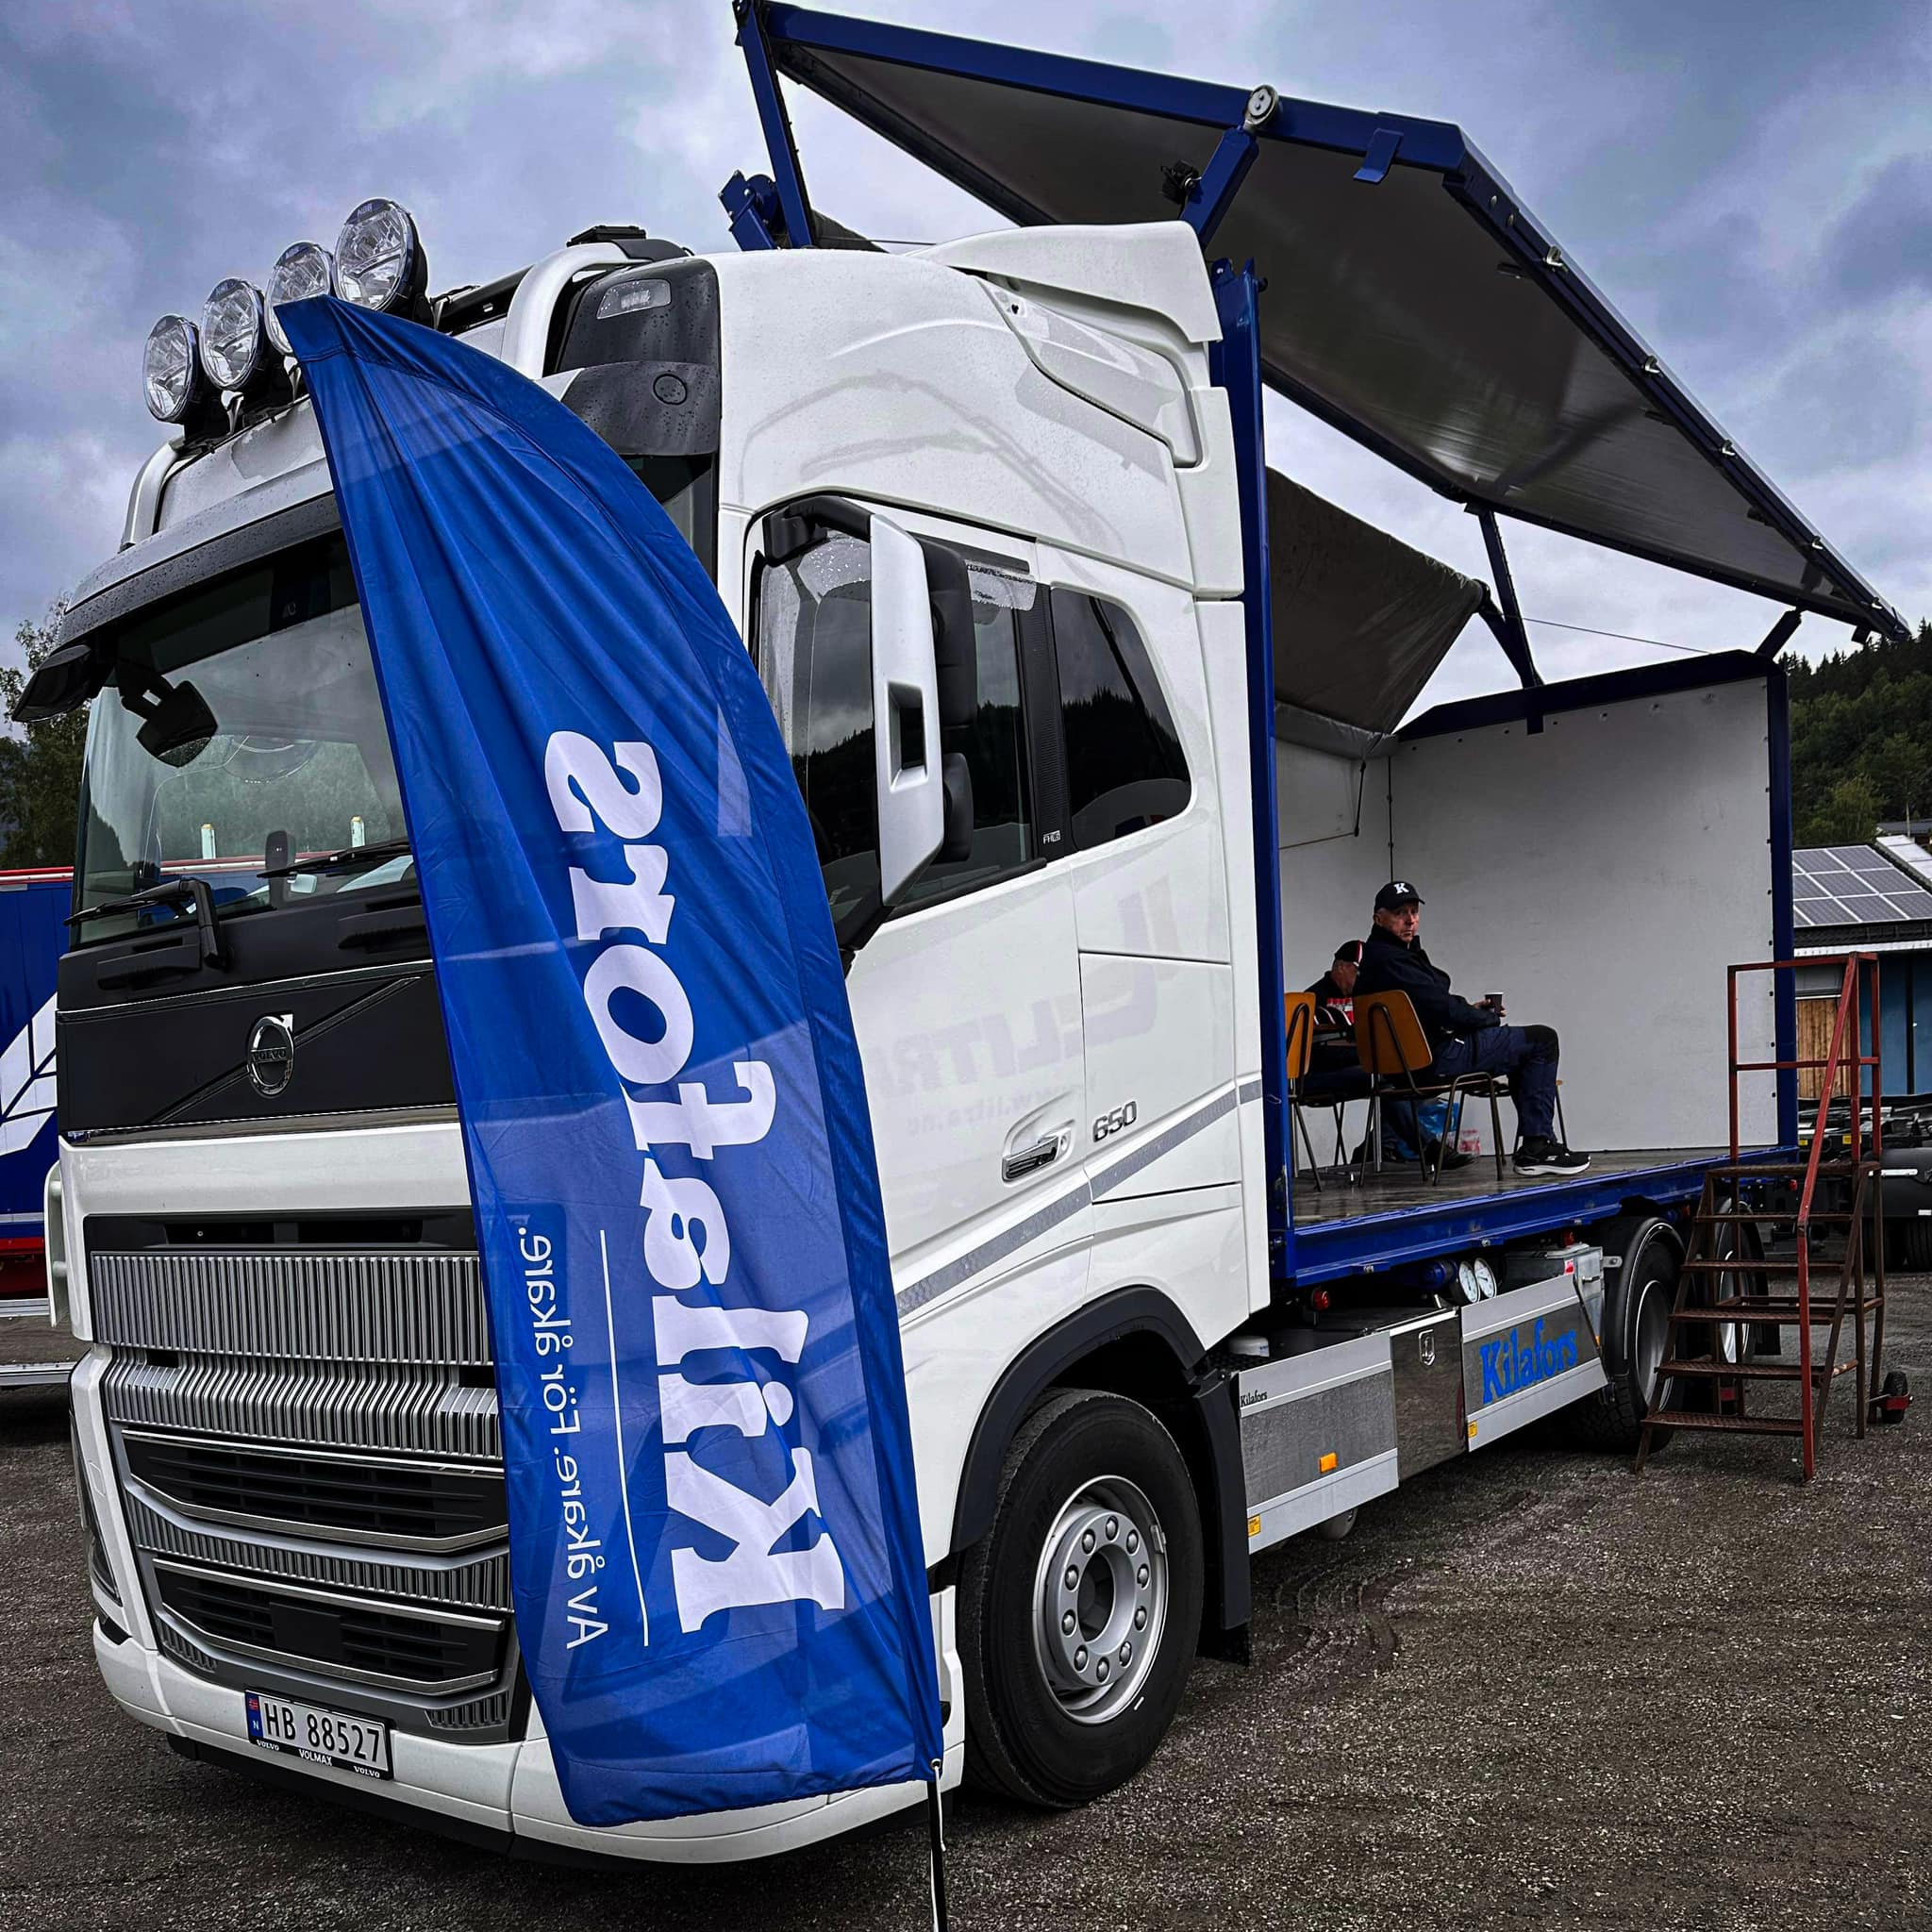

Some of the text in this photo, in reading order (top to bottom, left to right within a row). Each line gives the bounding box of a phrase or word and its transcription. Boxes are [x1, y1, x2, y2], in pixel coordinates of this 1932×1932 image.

[1394, 882, 1409, 894] K
[252, 1048, 287, 1062] VOLVO
[1092, 1100, 1138, 1143] 650
[1479, 1316, 1577, 1405] Kilafors
[1240, 1389, 1268, 1407] Kilafors
[252, 1720, 259, 1731] N
[264, 1703, 379, 1762] HB 88527
[257, 1740, 279, 1751] VOLVO
[298, 1748, 333, 1766] VOLMAX
[354, 1766, 380, 1777] VOLVO
